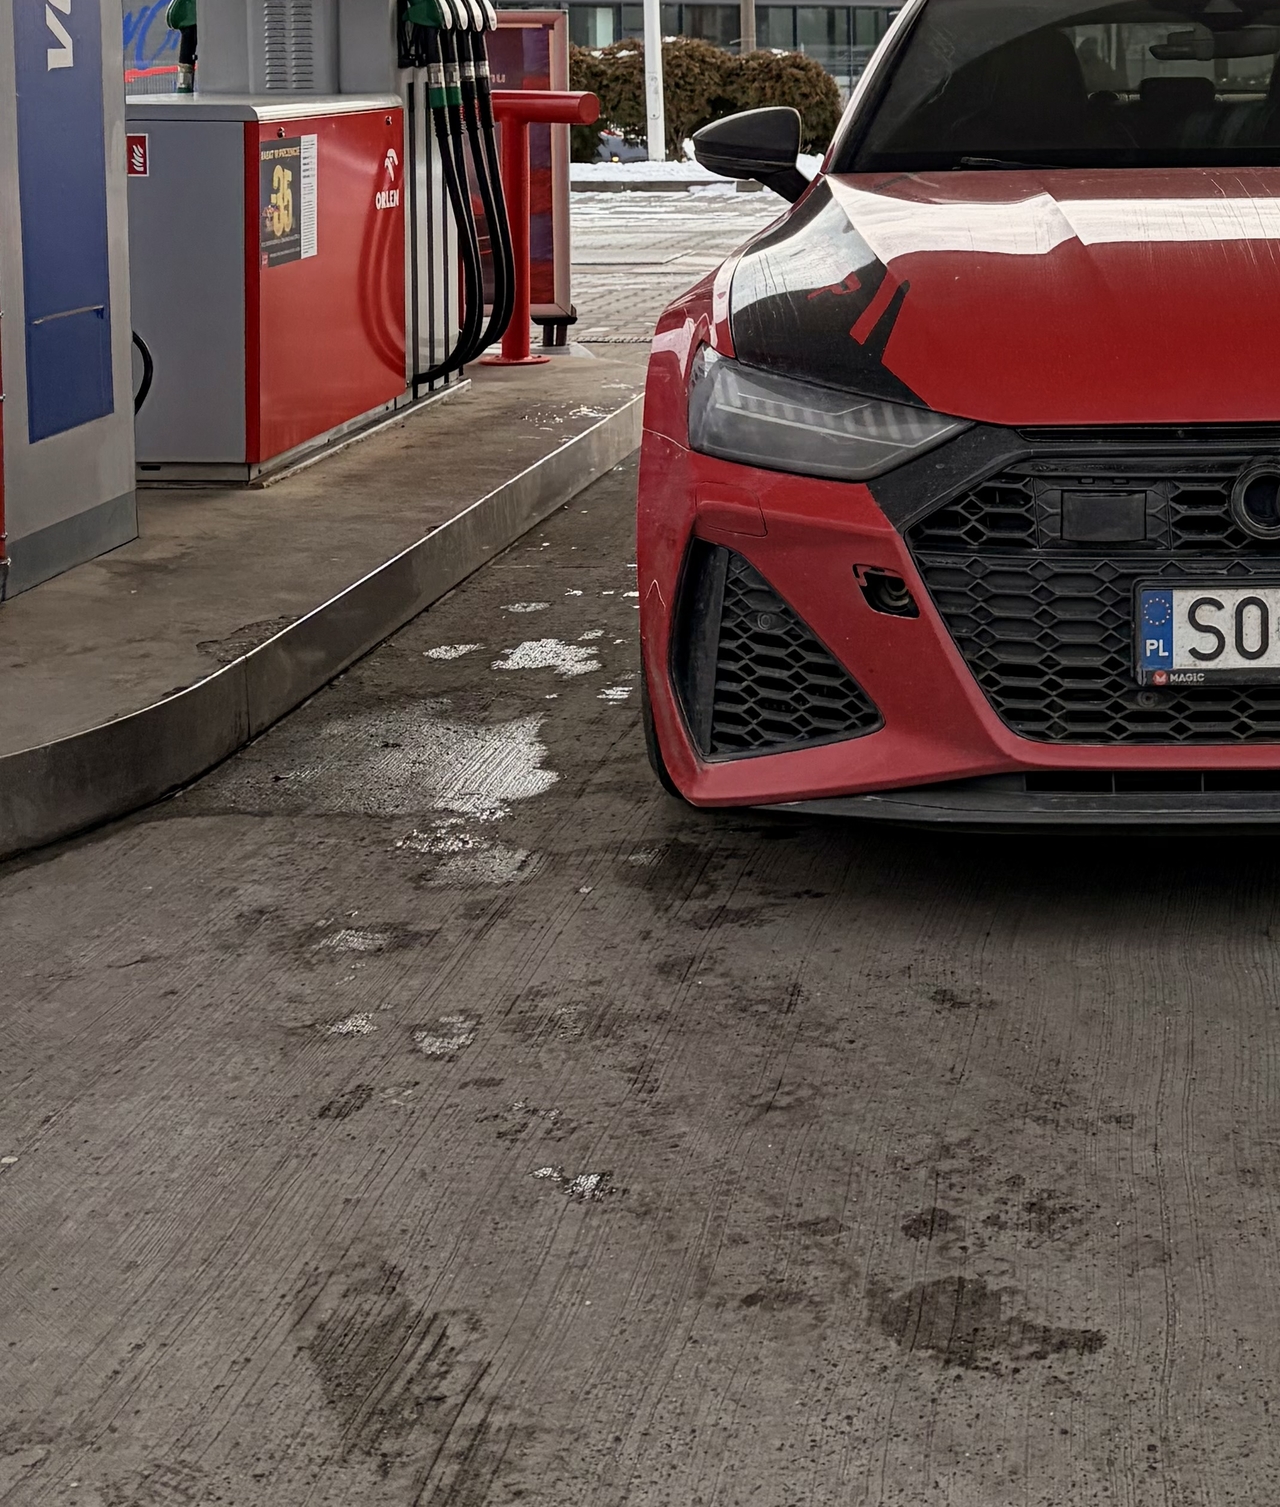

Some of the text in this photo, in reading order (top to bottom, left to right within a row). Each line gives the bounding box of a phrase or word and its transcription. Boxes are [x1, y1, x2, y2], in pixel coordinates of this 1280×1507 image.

[375, 189, 400, 209] ORLEN
[1146, 639, 1169, 657] PL
[1170, 673, 1205, 682] MAGIC
